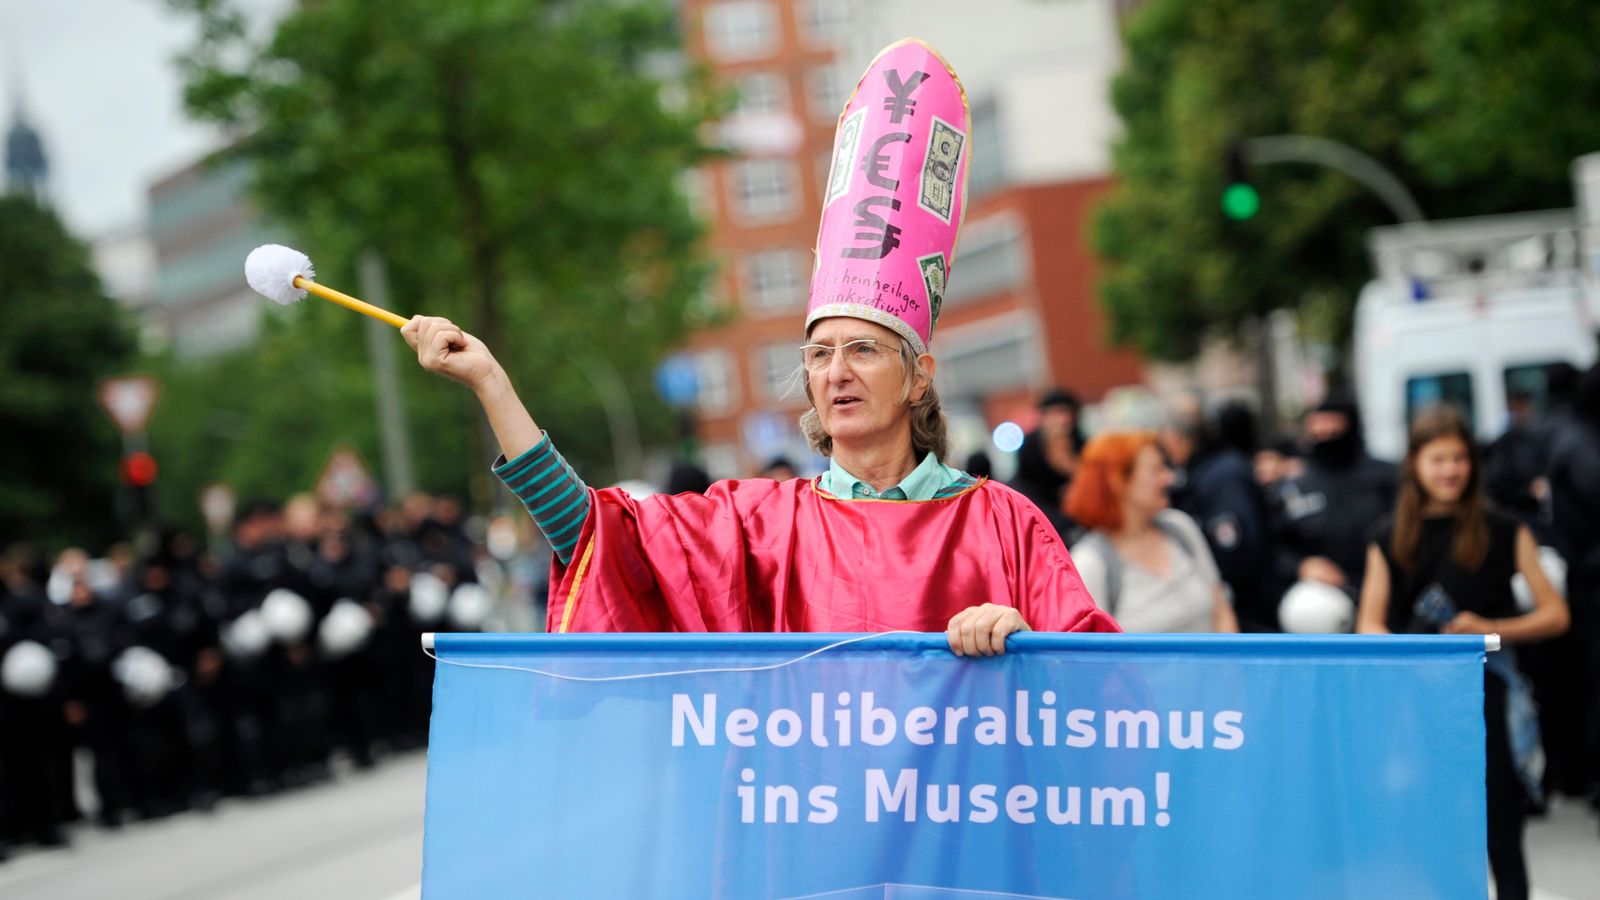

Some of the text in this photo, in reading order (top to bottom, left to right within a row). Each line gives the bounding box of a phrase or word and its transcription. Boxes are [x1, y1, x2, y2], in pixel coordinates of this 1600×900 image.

[671, 691, 1245, 750] Neoliberalismus
[737, 768, 1170, 828] ins Museum!
